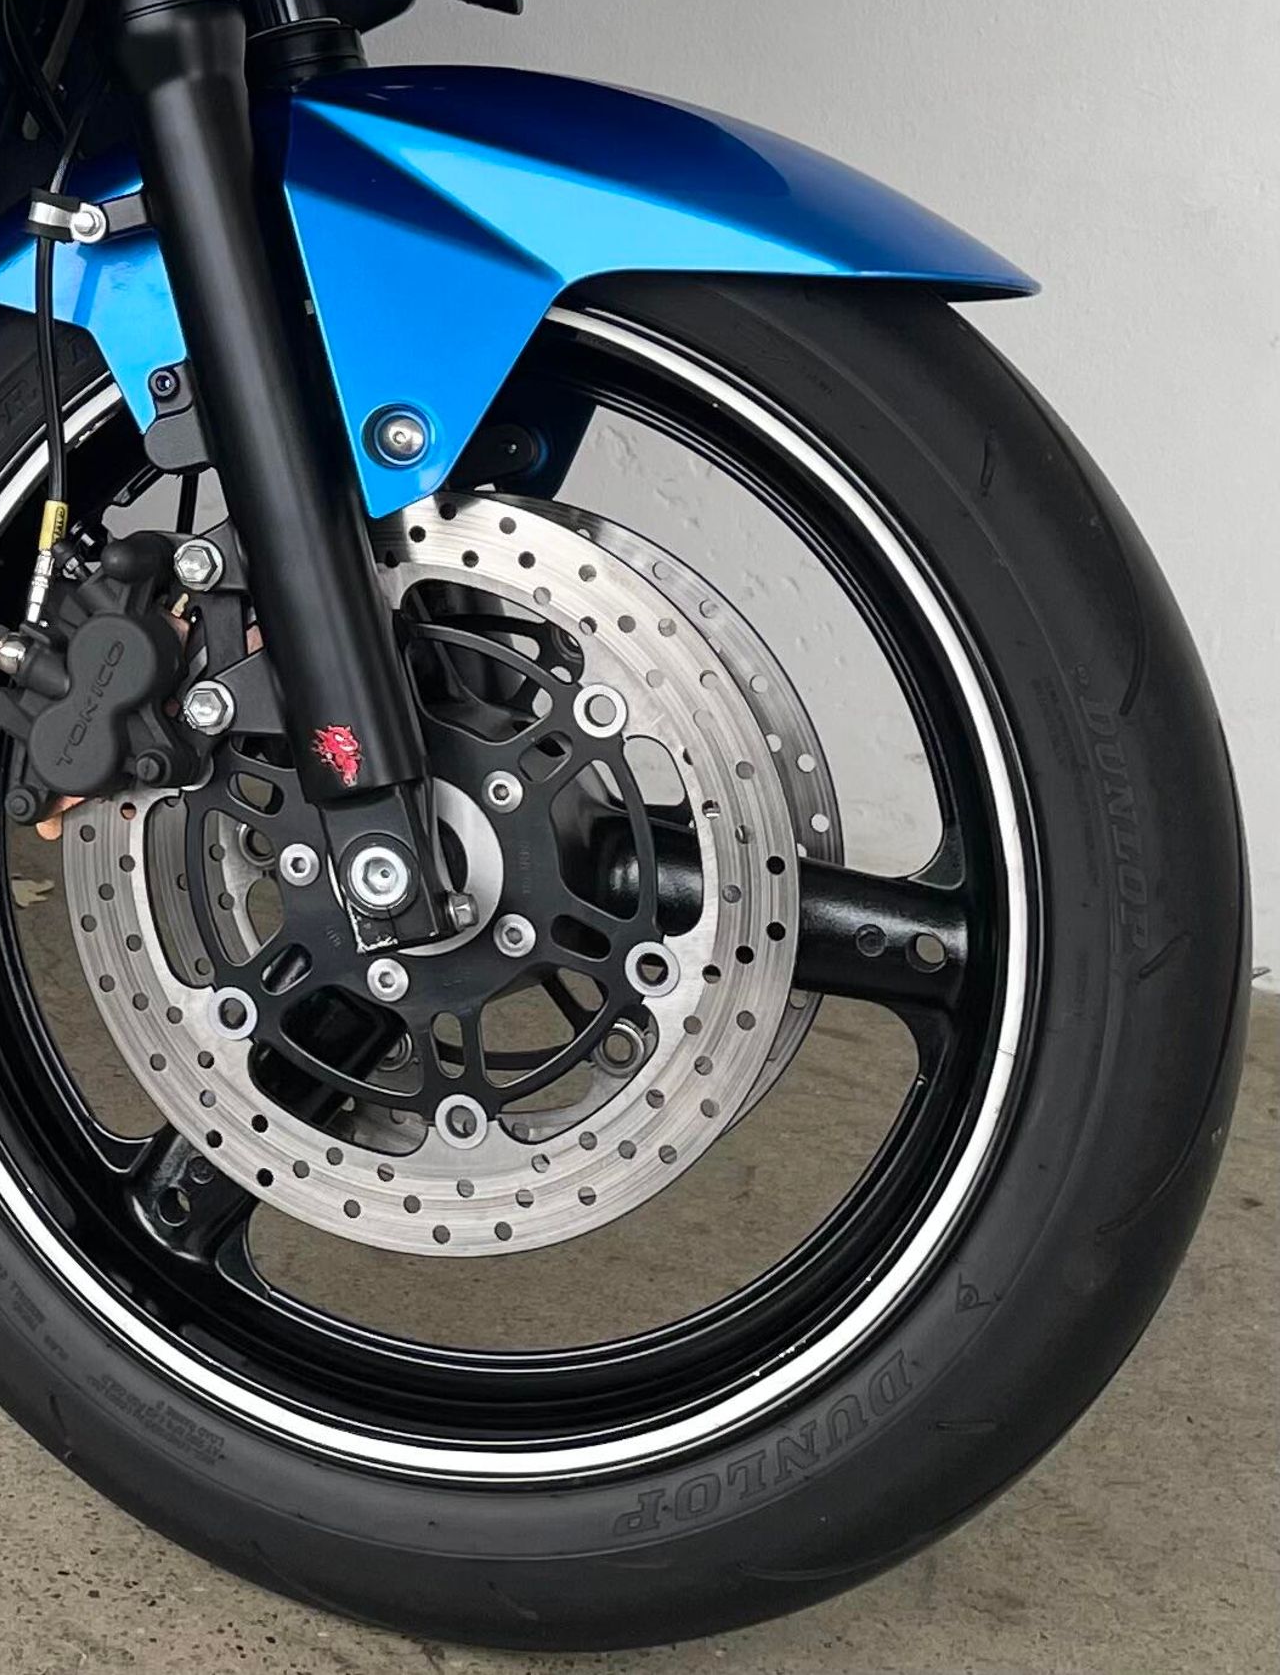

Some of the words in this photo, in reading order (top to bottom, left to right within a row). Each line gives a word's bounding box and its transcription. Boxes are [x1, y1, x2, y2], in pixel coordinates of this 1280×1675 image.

[54, 638, 125, 768] TOKICO
[1079, 694, 1149, 950] DUNLOP
[613, 1349, 914, 1538] DUNLOP
